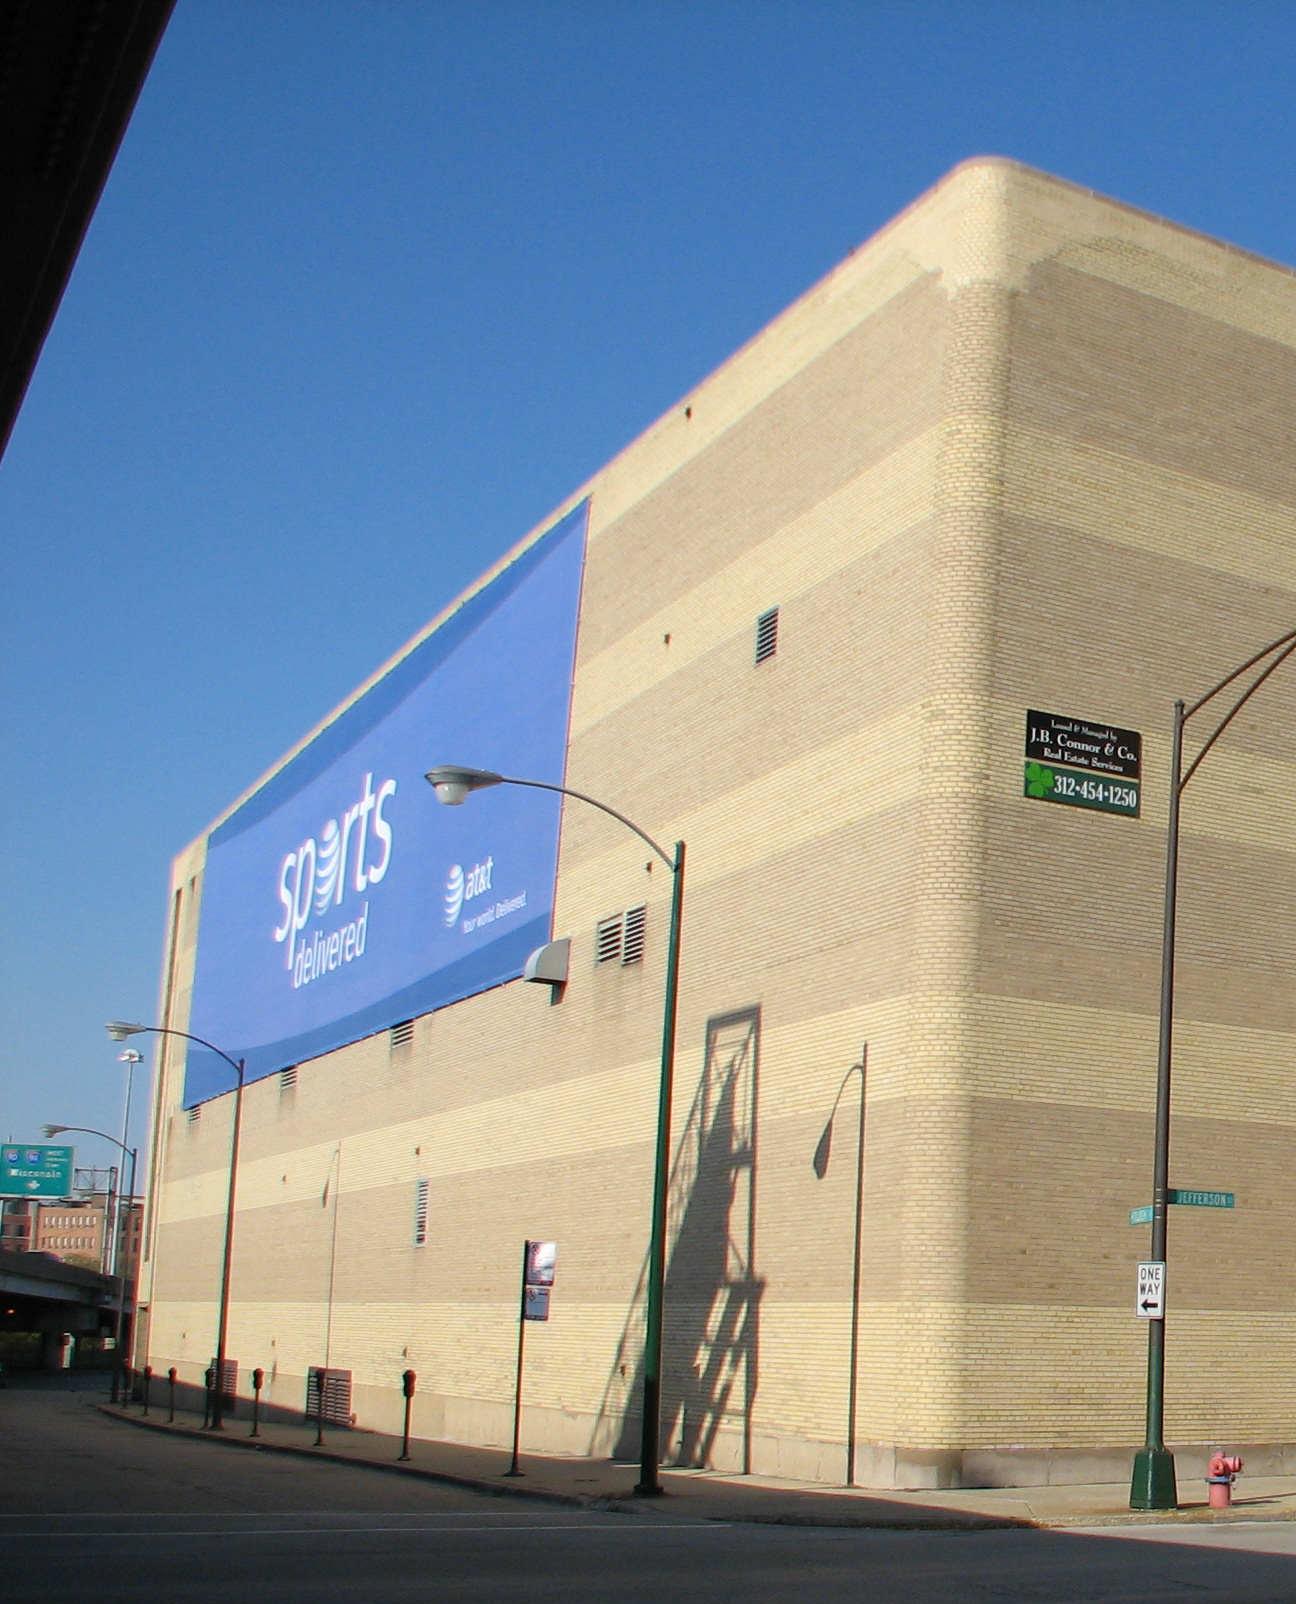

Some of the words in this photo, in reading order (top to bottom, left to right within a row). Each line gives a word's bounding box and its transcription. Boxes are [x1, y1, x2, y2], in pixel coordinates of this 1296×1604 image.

[1030, 727, 1053, 745] J.B.
[1057, 733, 1101, 754] Connor
[1104, 742, 1115, 757] &
[1117, 745, 1137, 762] Co.
[1043, 747, 1062, 761] Real
[1064, 751, 1090, 766] Estate
[1091, 756, 1124, 772] Services
[465, 855, 494, 900] at&t
[294, 900, 369, 989] delivered
[1180, 1191, 1226, 1207] JEFFERSON
[1140, 1268, 1161, 1280] ONE
[1140, 1283, 1161, 1296] WAY
